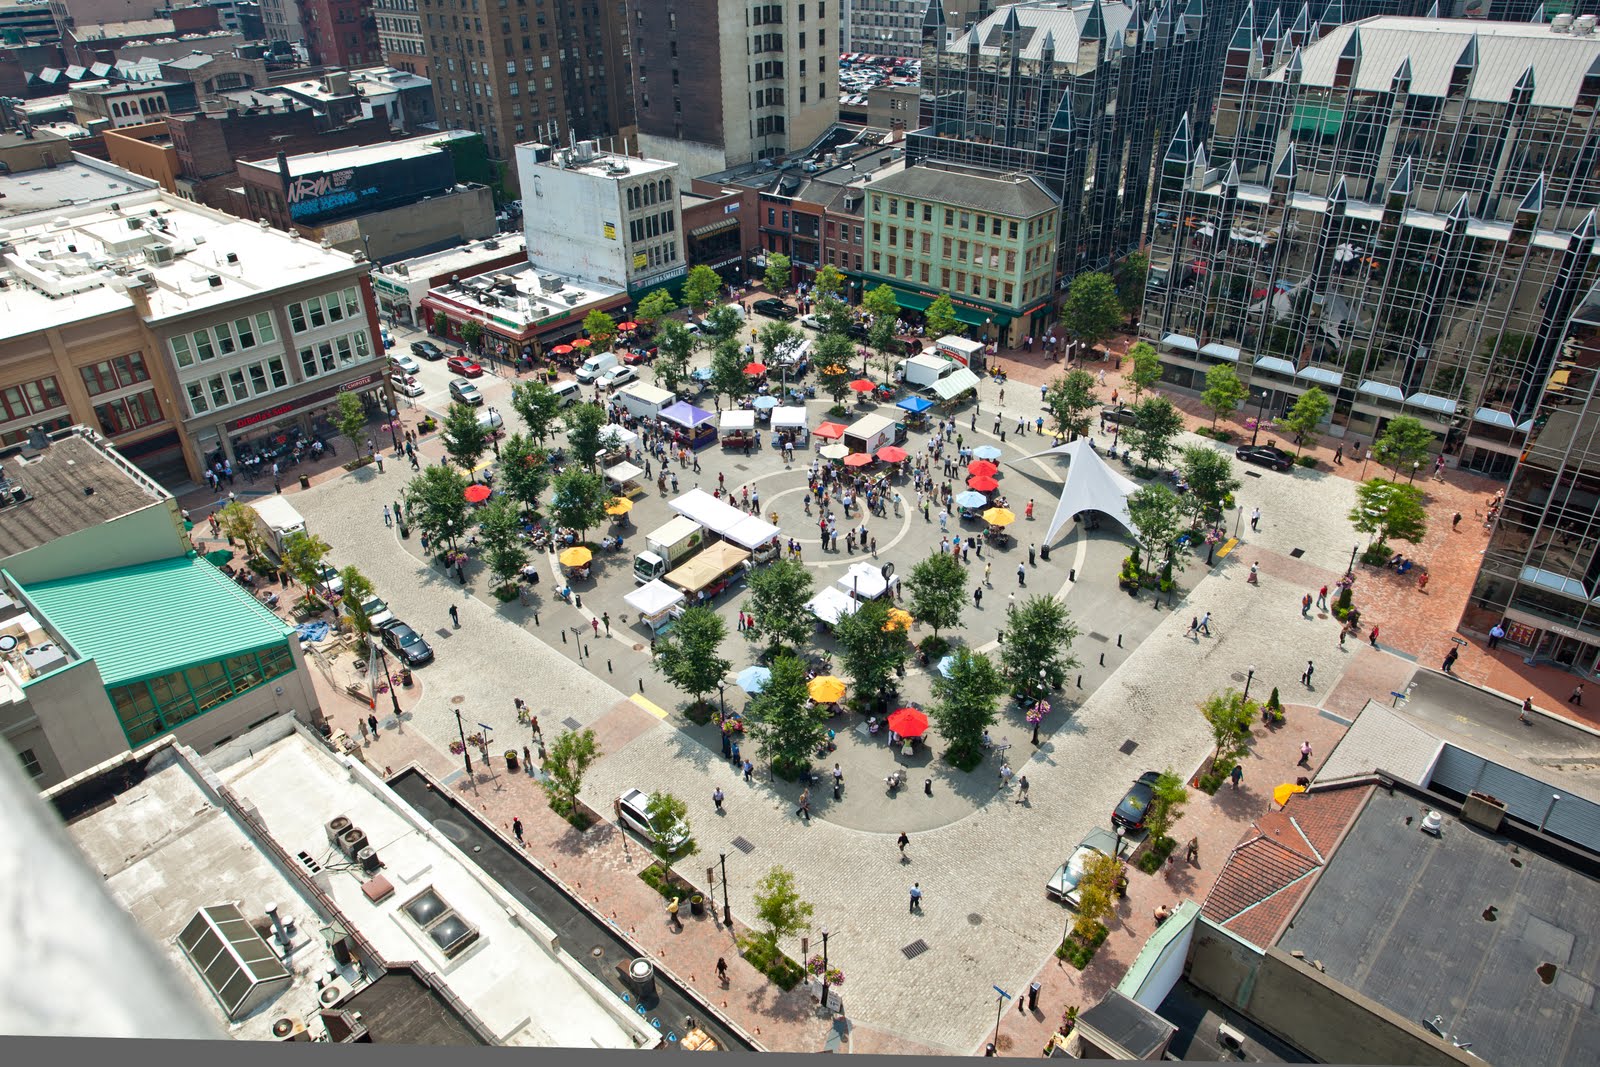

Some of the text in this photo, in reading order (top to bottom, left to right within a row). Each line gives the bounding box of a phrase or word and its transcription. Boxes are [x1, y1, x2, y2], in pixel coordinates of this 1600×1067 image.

[288, 176, 334, 203] NRM
[347, 377, 371, 390] CHIPOTLE
[1551, 625, 1575, 638] GNC
